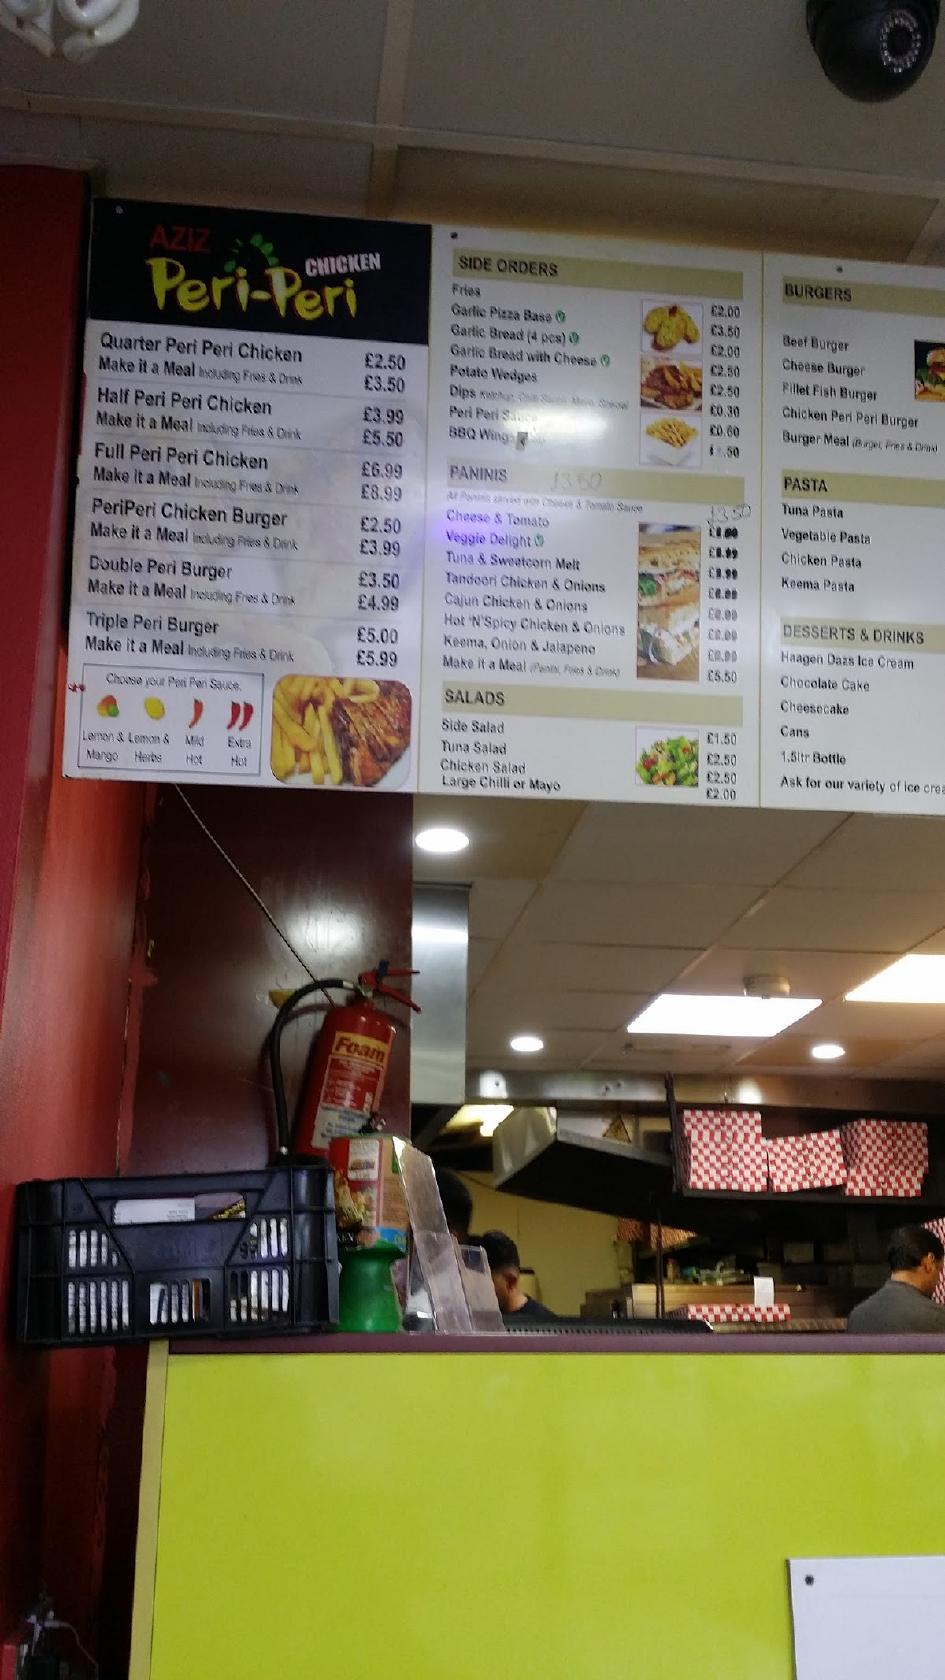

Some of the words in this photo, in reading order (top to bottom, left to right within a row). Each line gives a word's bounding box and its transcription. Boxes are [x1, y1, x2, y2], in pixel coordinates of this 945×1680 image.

[150, 224, 212, 250] AZIZ
[305, 252, 381, 277] CHICKEN
[458, 255, 492, 271] SIDE
[497, 259, 558, 277] ORDERS
[145, 257, 358, 321] Peri-Peri
[452, 283, 481, 297] Fries
[784, 283, 852, 302] BURGERS
[451, 303, 486, 319] Garlic
[490, 305, 520, 321] Pizza
[524, 309, 552, 322] Base
[711, 305, 740, 319] £2.00
[451, 325, 486, 341] Garlic
[489, 327, 524, 341] Bread
[710, 325, 740, 338] £3.50
[100, 332, 161, 351] Quarter
[166, 337, 197, 354] Peri
[202, 341, 233, 358] Peri
[238, 343, 302, 362] Chicken
[710, 345, 739, 358] £2.00
[782, 334, 808, 348] Beef
[811, 336, 849, 353] Burger
[365, 352, 406, 370] £2.50
[451, 345, 485, 358] Garlic
[489, 347, 523, 360] Bread
[527, 351, 551, 364] with
[554, 355, 597, 368] Cheese
[99, 356, 135, 373] Make
[139, 359, 147, 373] it
[151, 362, 159, 375] a
[163, 361, 195, 376] Meal
[269, 372, 276, 383] &
[450, 365, 487, 380] Potato
[491, 370, 537, 384] Wedges
[710, 365, 739, 378] £2.50
[782, 358, 823, 373] Cheese
[828, 361, 865, 377] Burger
[364, 375, 405, 392] £3.50
[782, 382, 809, 396] Fillet
[813, 384, 836, 397] Fish
[840, 387, 877, 402] Burger
[98, 387, 130, 404] Half
[135, 390, 165, 407] Peri
[171, 393, 202, 409] Peri
[207, 395, 272, 414] Chicken
[450, 385, 476, 401] Dips
[363, 407, 404, 423] £3.99
[782, 406, 827, 422] Chicken
[832, 410, 852, 422] Peri
[857, 412, 878, 424] Peri
[882, 413, 918, 429] Burger
[362, 430, 403, 447] £5.50
[782, 430, 821, 447] Burger
[824, 434, 849, 447] Meal
[95, 441, 124, 459] Full
[130, 445, 161, 462] Peri
[167, 448, 198, 465] Peri
[203, 450, 269, 470] Chicken
[361, 461, 402, 478] £6.99
[450, 465, 507, 482] PANINIS
[361, 483, 402, 501] £8.99
[784, 476, 827, 492] PASTA
[91, 498, 155, 518] PeriPeri
[161, 502, 227, 523] Chicken
[233, 507, 288, 529] Burger
[782, 503, 808, 517] Tuna
[813, 505, 843, 518] Pasta
[360, 515, 401, 534] £2.50
[446, 530, 486, 545] Veggie
[490, 532, 531, 547] Delight
[781, 528, 836, 543] Vegetable
[840, 531, 871, 544] Pasta
[360, 539, 400, 557] £3.99
[89, 555, 143, 574] Double
[147, 559, 176, 575] Peri
[181, 561, 233, 581] Burger
[446, 551, 473, 564] Tuna
[478, 554, 486, 565] &
[490, 553, 551, 569] Sweetcorn
[556, 558, 580, 570] Melt
[781, 552, 827, 566] Chicken
[831, 554, 862, 569] Pasta
[359, 571, 400, 589] £3.50
[782, 576, 819, 590] Keema
[824, 579, 854, 592] Pasta
[358, 595, 399, 612] £4.99
[87, 611, 128, 631] Triple
[133, 614, 163, 631] Peri
[167, 617, 219, 636] Burger
[444, 613, 465, 626] Hot
[520, 619, 567, 633] Chicken
[572, 622, 580, 633] &
[584, 621, 625, 636] Onions
[357, 627, 398, 645] £5.00
[783, 625, 855, 641] DESSERTS
[860, 629, 869, 641] &
[874, 629, 924, 645] DRINKS
[356, 650, 397, 668] £5.99
[781, 651, 823, 667] Haagen
[827, 654, 855, 666] Dazs
[858, 656, 874, 667] Ice
[878, 655, 914, 670] Cream
[106, 673, 142, 685] Choose
[145, 677, 165, 688] your
[168, 677, 185, 687] Peri
[189, 678, 206, 688] Peri
[707, 670, 737, 683] £5.50
[781, 676, 838, 690] Chocolate
[842, 678, 870, 692] Cake
[445, 689, 505, 706] SALADS
[781, 700, 849, 715] Cheesecake
[442, 719, 468, 732] Side
[472, 721, 505, 734] Salad
[781, 725, 810, 738] Cans
[83, 730, 114, 742] Lemon
[117, 732, 124, 742] &
[129, 733, 160, 744] Lemon
[163, 735, 170, 745] &
[185, 735, 204, 746] Mild
[228, 737, 251, 748] Extra
[707, 733, 737, 745] £1.50
[87, 749, 119, 762] Mango
[441, 739, 469, 753] Tuna
[473, 741, 507, 755] Salad
[134, 751, 162, 763] Herbs
[186, 755, 202, 765] Hot
[231, 755, 247, 767] Hot
[707, 754, 737, 767] £2.50
[782, 751, 809, 763] 1.5ltr
[813, 752, 846, 765] Bottle
[440, 758, 488, 773] Chicken
[493, 761, 525, 774] Salad
[442, 775, 476, 789] Large
[479, 777, 509, 789] Chilli
[514, 780, 525, 789] or
[530, 780, 560, 793] Mayo
[780, 776, 802, 788] Ask
[806, 777, 821, 789] for
[825, 780, 844, 790] our
[848, 780, 885, 794] variety
[890, 781, 901, 792] of
[905, 781, 920, 793] ice
[336, 1036, 385, 1063] Foam
